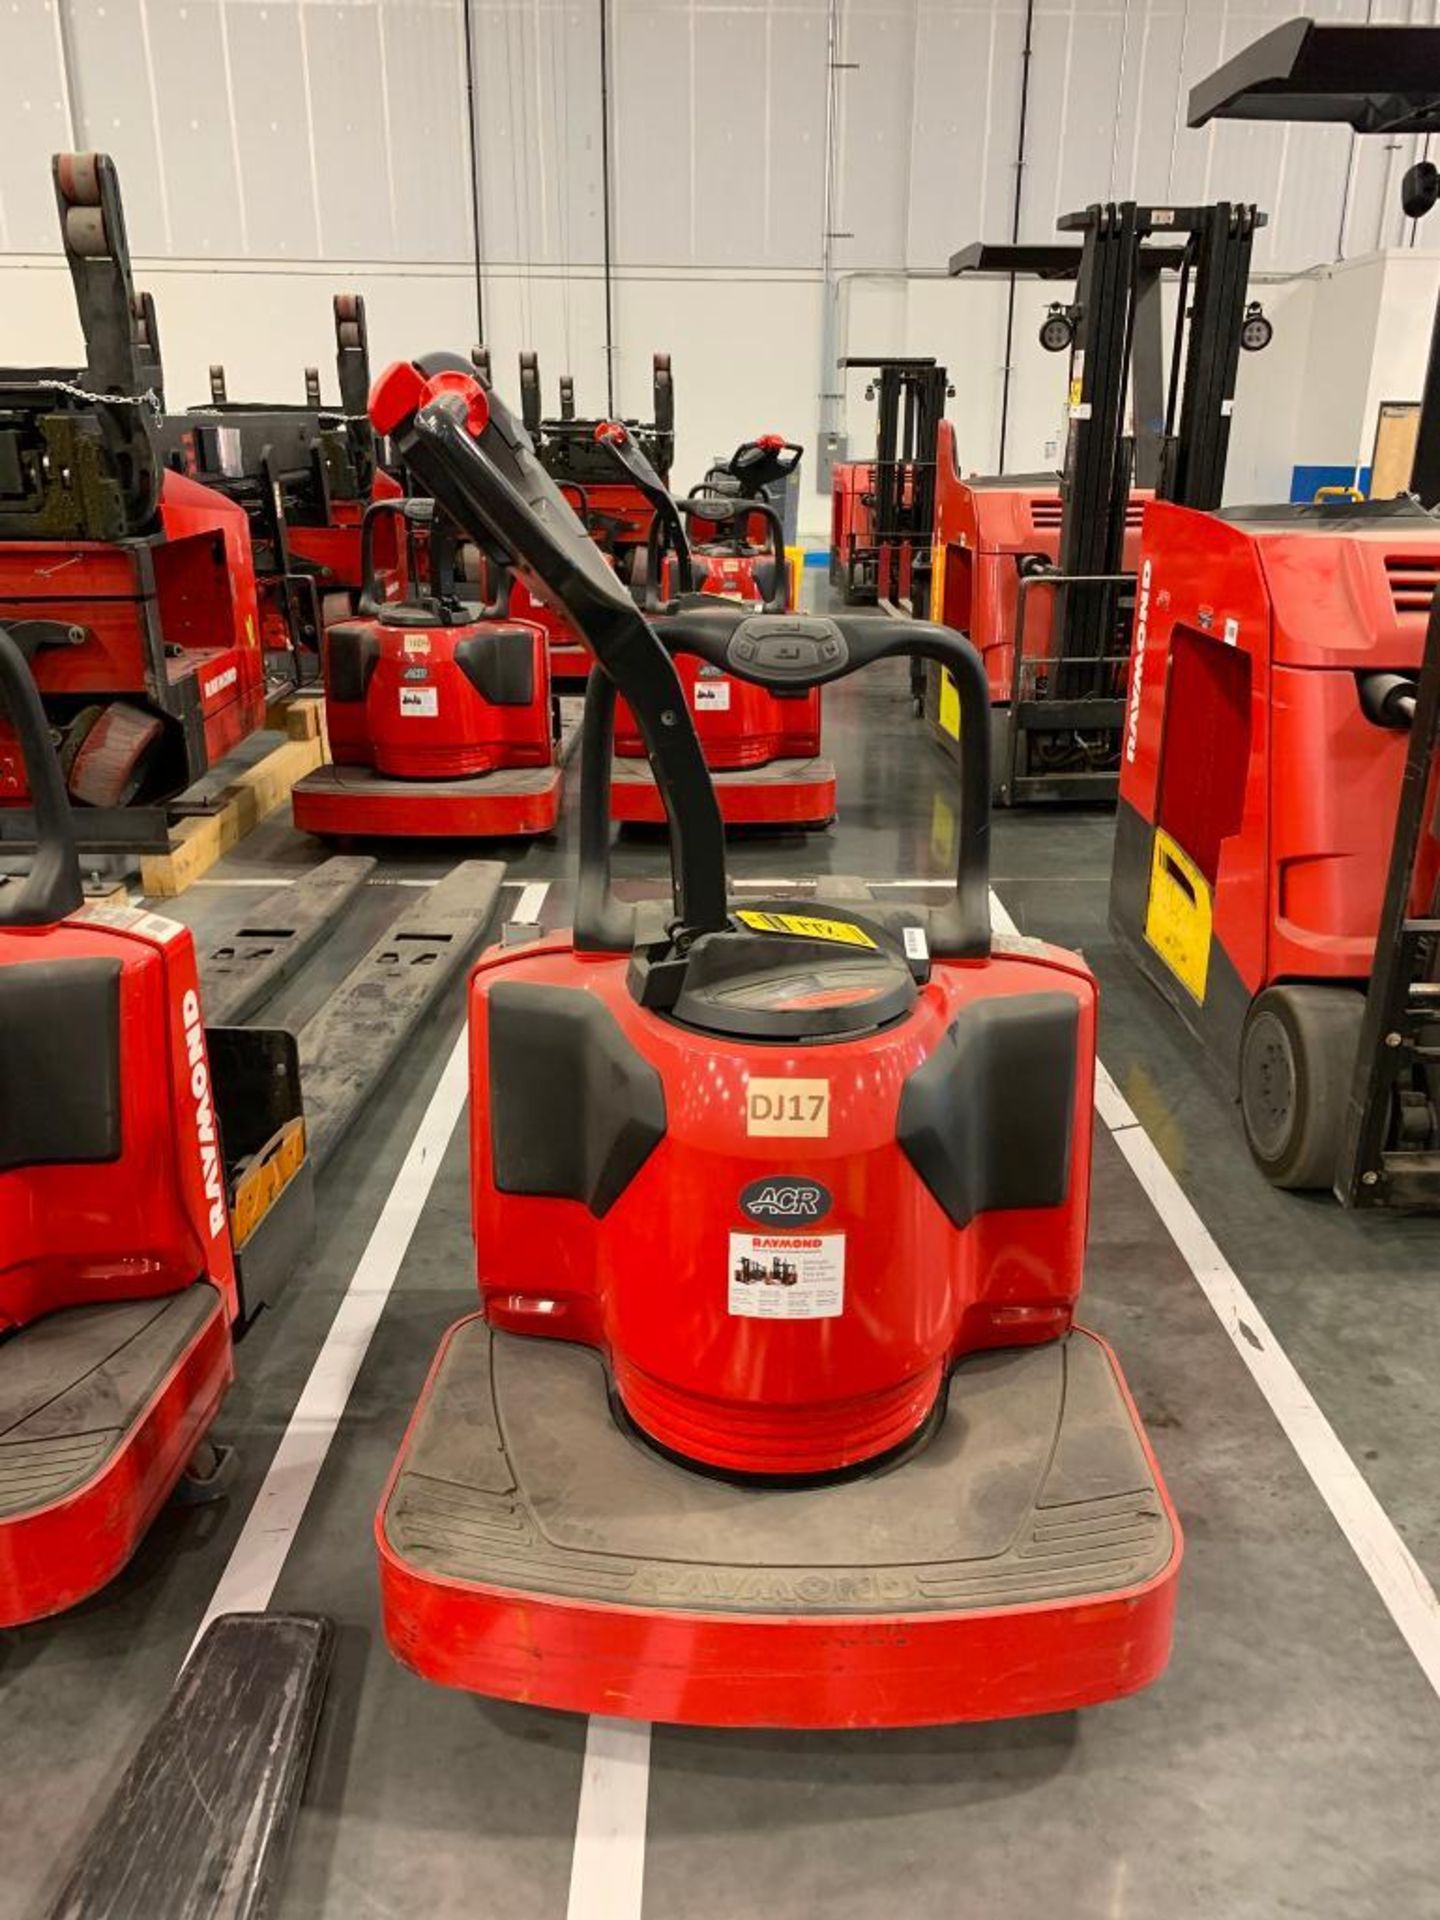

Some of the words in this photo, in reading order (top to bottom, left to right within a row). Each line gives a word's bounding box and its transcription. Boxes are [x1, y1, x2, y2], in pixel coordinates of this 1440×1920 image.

[1127, 559, 1152, 763] RAYMOND
[183, 989, 225, 1239] RAYMOND
[750, 1094, 825, 1122] DJ17
[747, 1187, 820, 1215] ACR
[752, 1238, 823, 1249] RAYMOND
